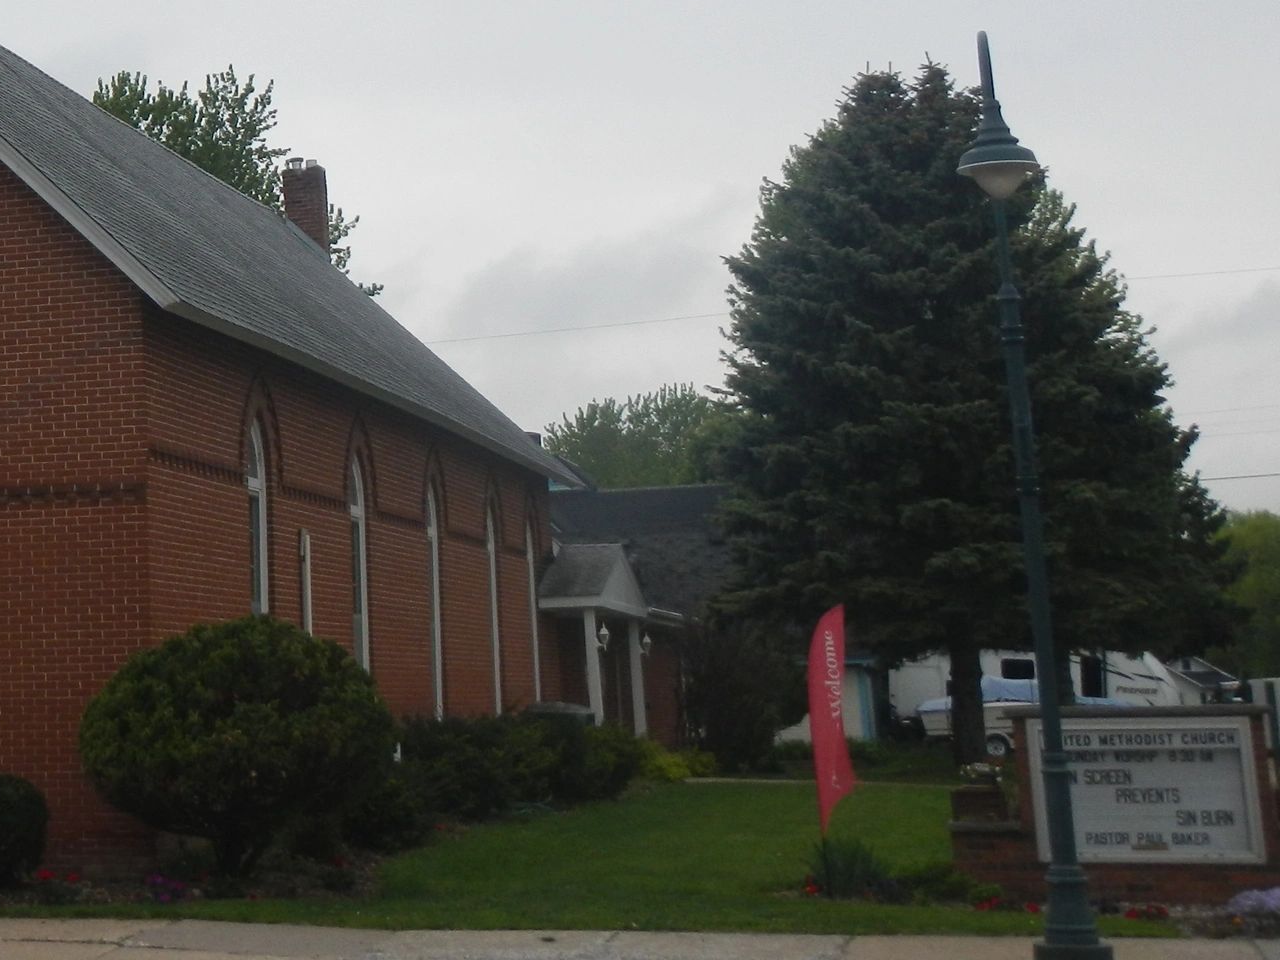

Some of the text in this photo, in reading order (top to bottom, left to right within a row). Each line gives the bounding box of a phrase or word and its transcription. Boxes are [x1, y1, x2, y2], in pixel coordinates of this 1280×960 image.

[824, 630, 841, 718] Welcome
[1062, 732, 1234, 746] ITED METHODIST CHURCH
[1084, 769, 1131, 785] SCREEN
[1116, 788, 1180, 803] PREVENTS
[1176, 809, 1234, 826] SIN BURN
[1085, 832, 1129, 845] PASTOR
[1171, 832, 1210, 845] BAKER
